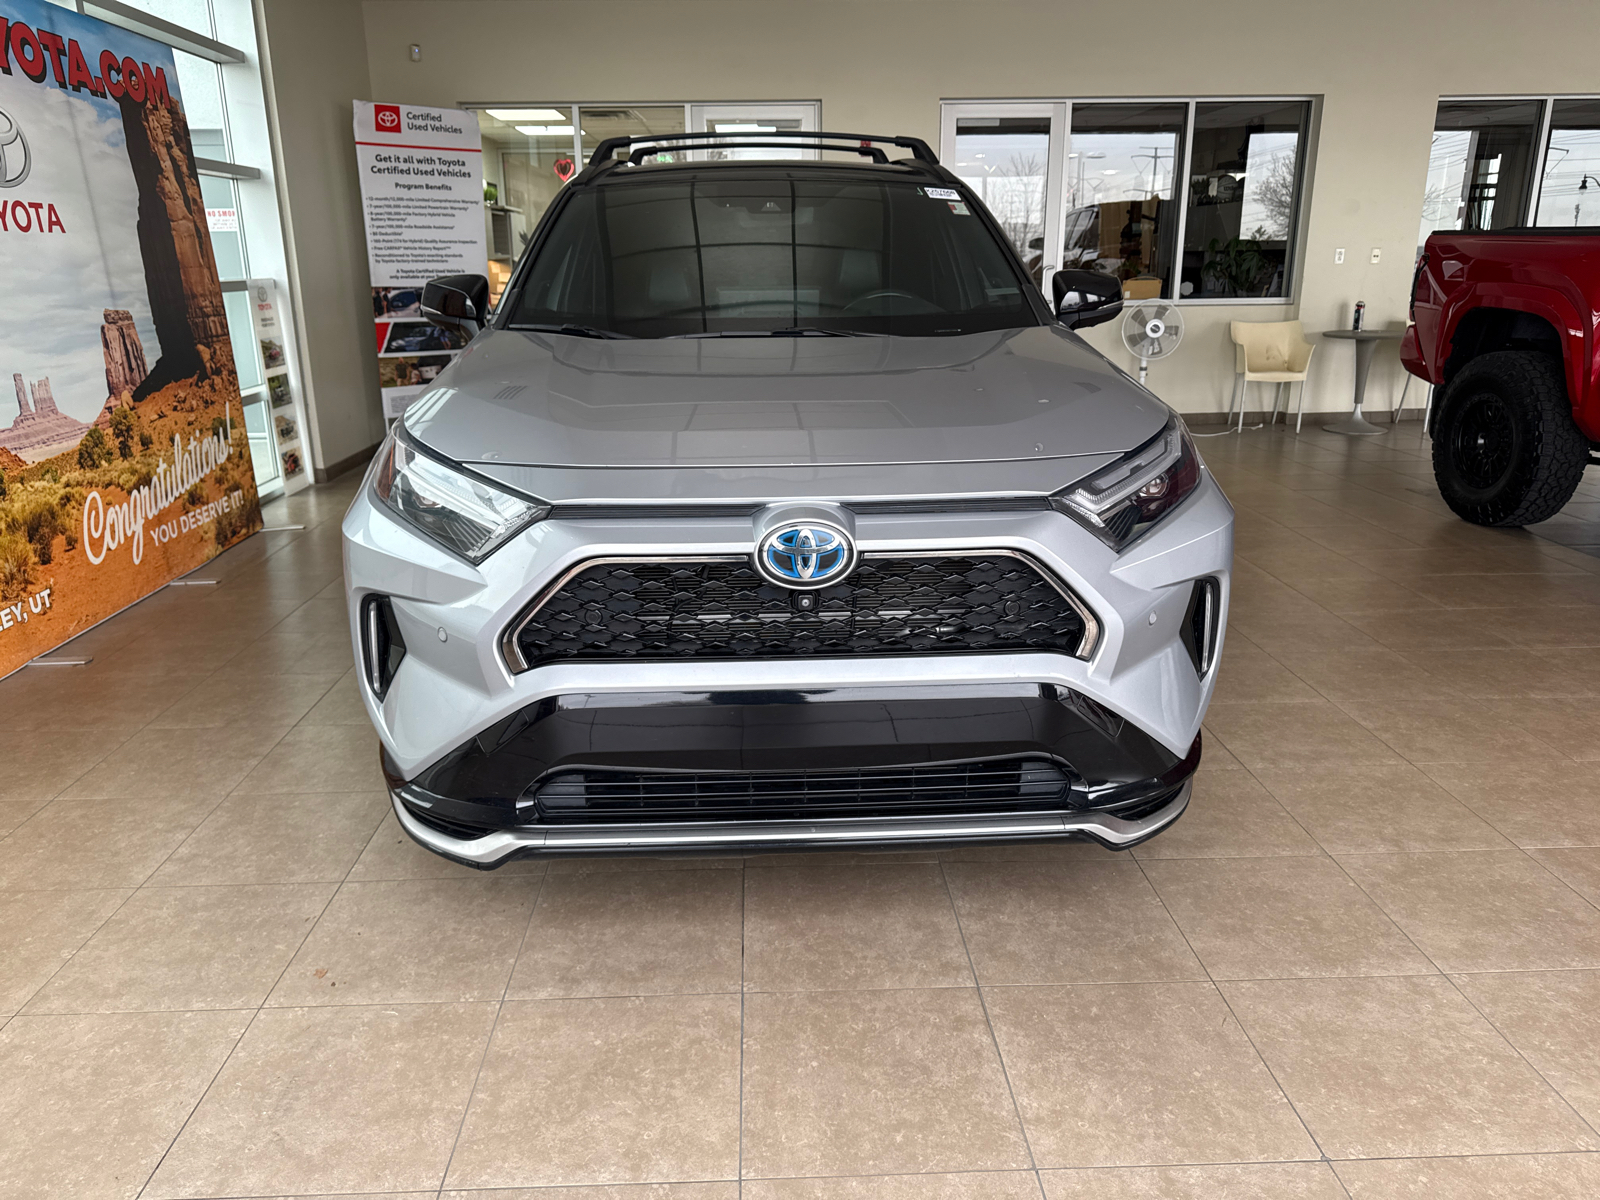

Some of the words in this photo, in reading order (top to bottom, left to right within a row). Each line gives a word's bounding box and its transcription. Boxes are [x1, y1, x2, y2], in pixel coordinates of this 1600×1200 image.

[406, 112, 442, 122] Certified
[407, 122, 428, 132] Used
[430, 124, 462, 134] Vehicles
[375, 154, 392, 163] Get
[394, 155, 400, 163] it
[403, 156, 414, 164] all
[416, 156, 436, 165] with
[437, 158, 466, 168] Toyota
[370, 165, 411, 175] Certified
[412, 167, 434, 176] Used
[436, 168, 472, 178] Vehicles
[395, 182, 424, 190] Program
[425, 183, 452, 191] Benefits
[84, 401, 234, 565] Congratulations!
[150, 520, 178, 546] YOU
[180, 496, 230, 534] DESERVE
[230, 489, 244, 509] IT!
[29, 588, 50, 614] UT
